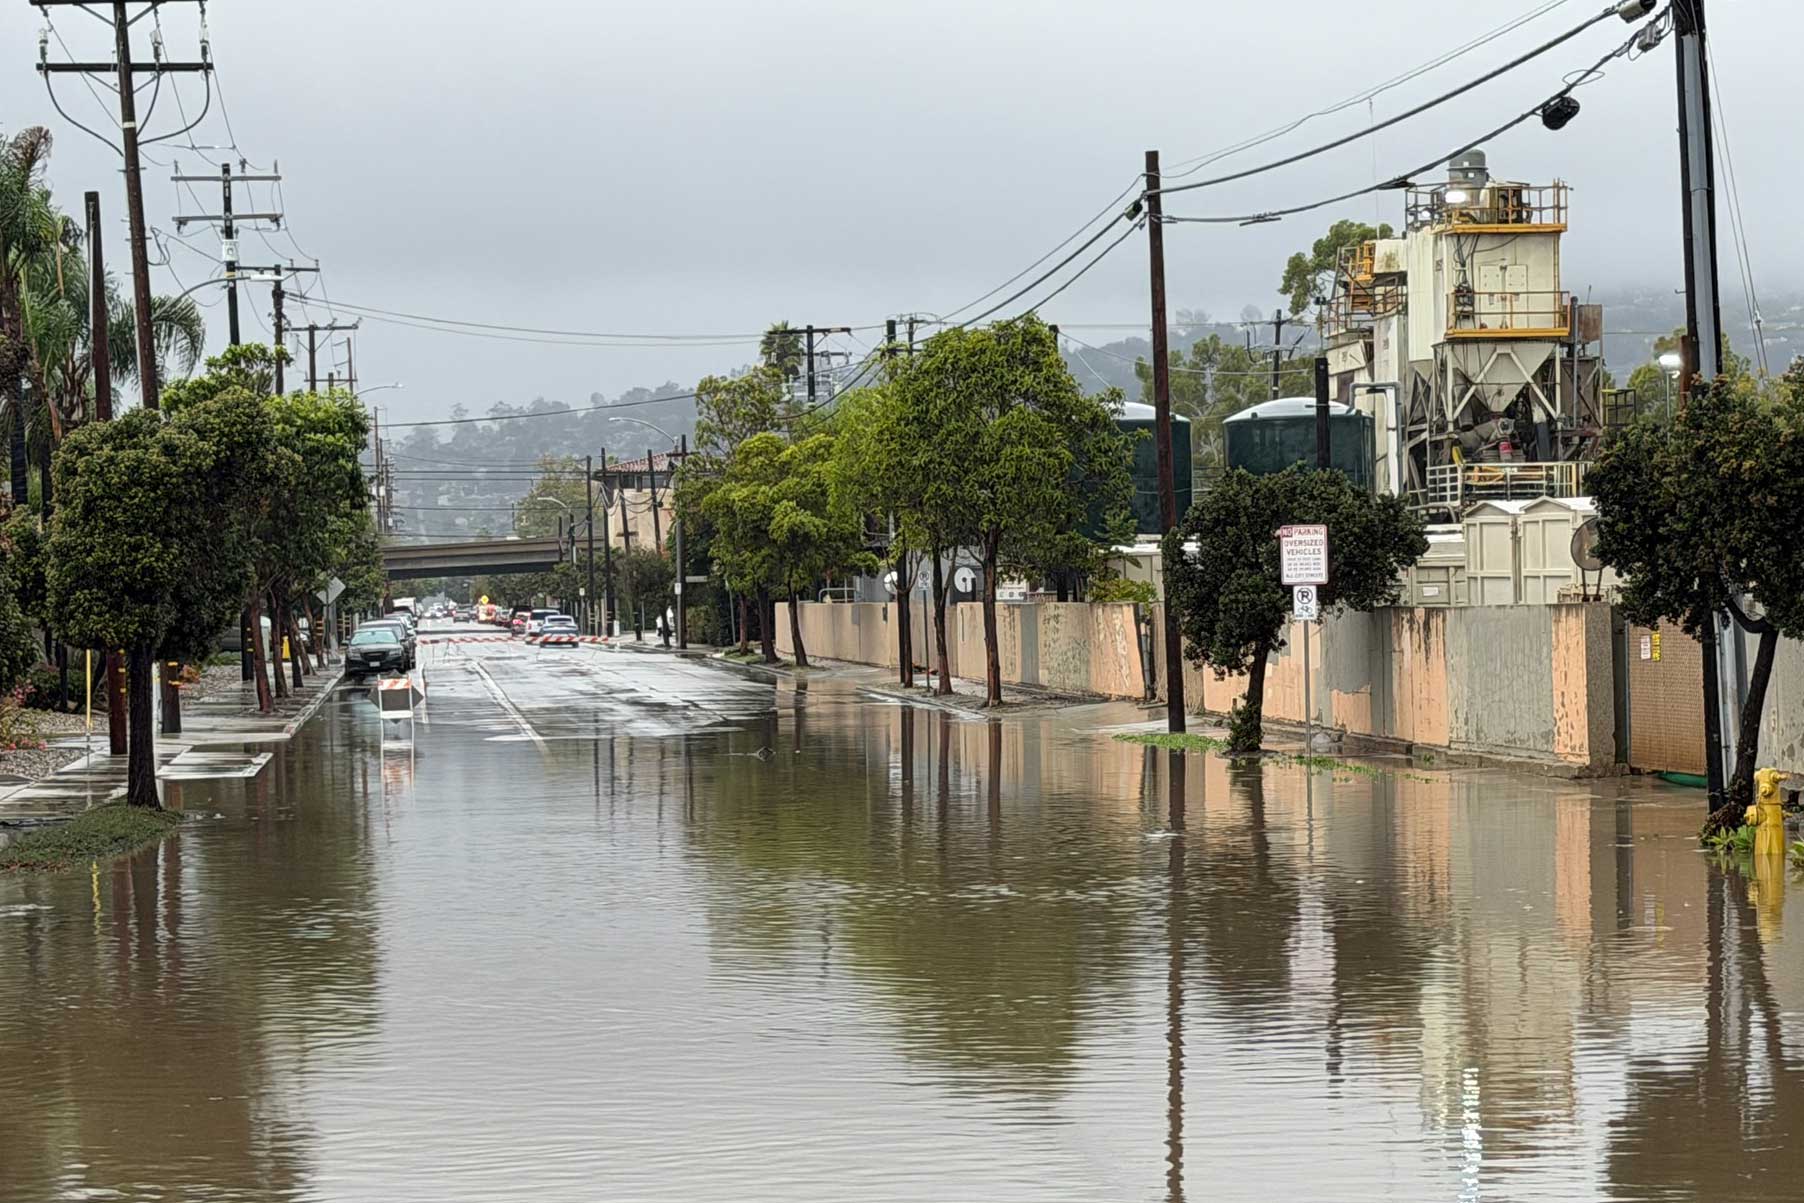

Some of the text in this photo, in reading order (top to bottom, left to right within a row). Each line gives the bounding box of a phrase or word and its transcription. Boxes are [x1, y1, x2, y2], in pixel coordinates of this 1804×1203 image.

[1282, 528, 1323, 536] NO PARKING
[1284, 539, 1323, 547] OVERSIZED
[1286, 548, 1322, 556] VEHICLES
